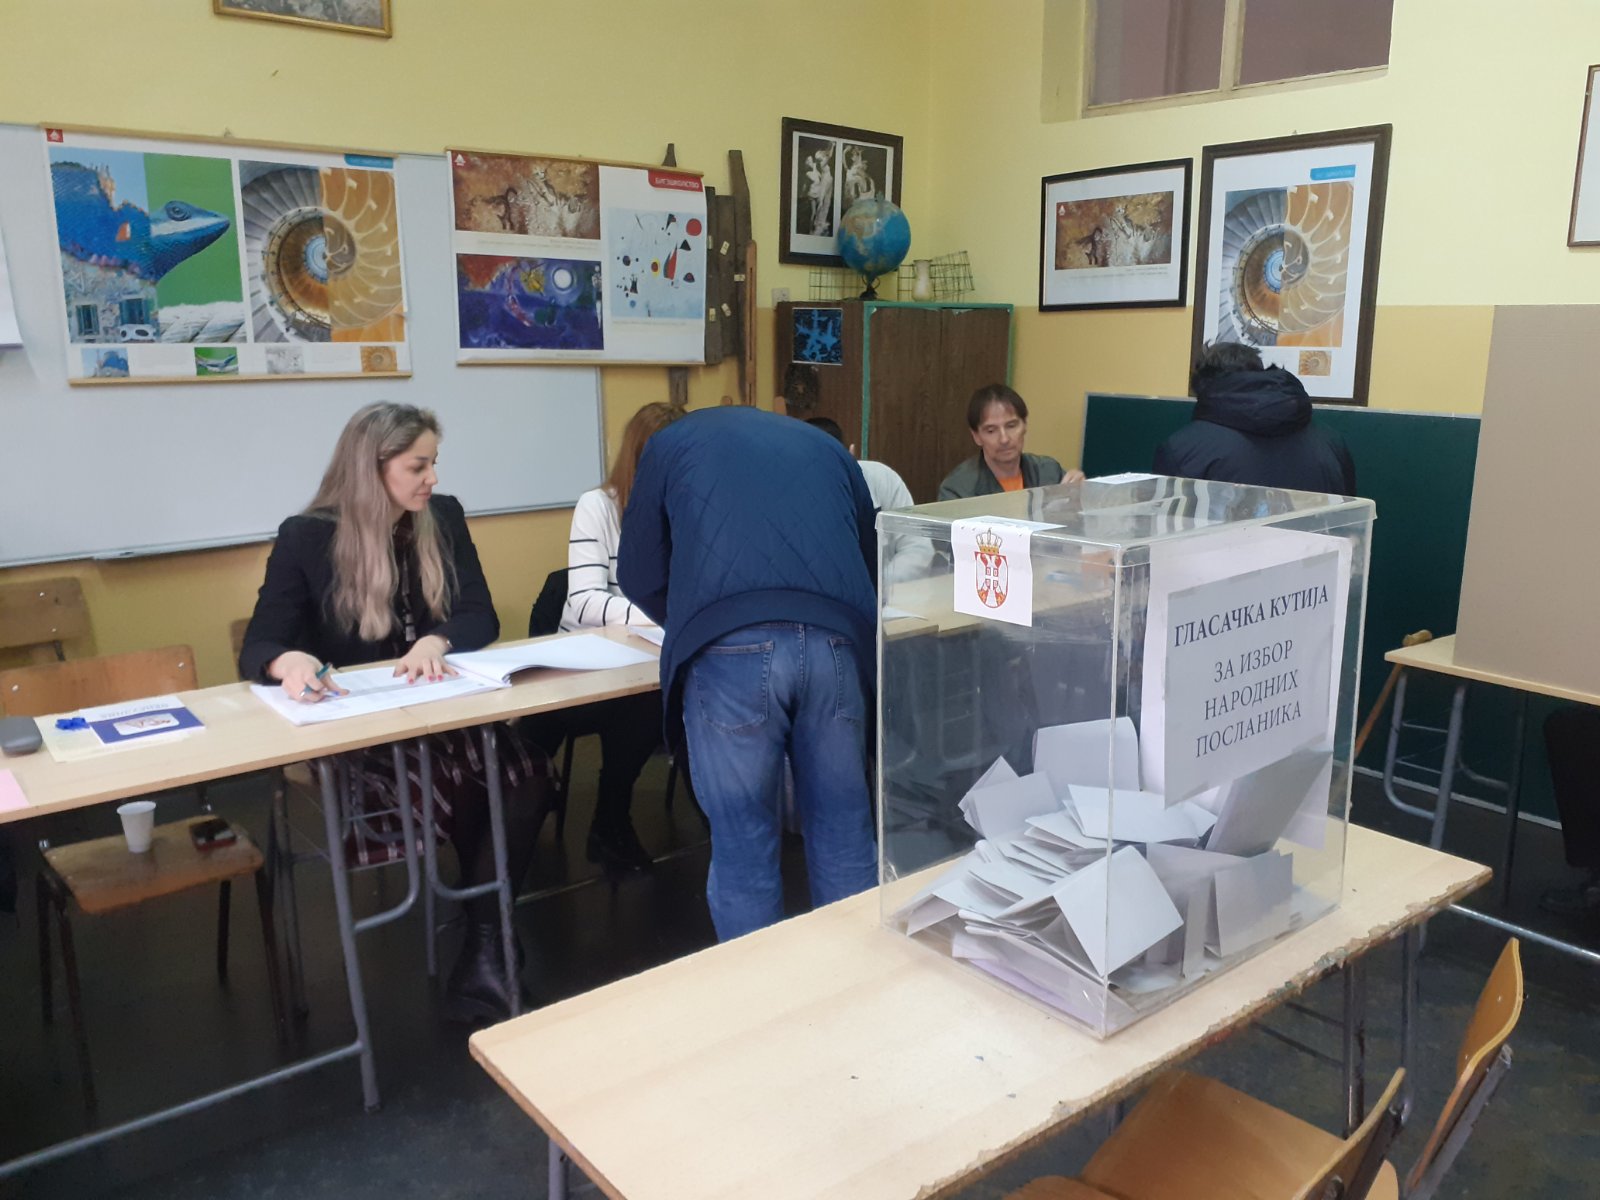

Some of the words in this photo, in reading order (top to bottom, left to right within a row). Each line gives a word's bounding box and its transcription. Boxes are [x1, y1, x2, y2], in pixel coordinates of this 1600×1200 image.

[1174, 602, 1265, 648] ГЛАСАЧКА
[1269, 584, 1329, 619] КУТИЈА
[1214, 659, 1235, 684] ЗА
[1240, 639, 1294, 675] ИЗБОР
[1204, 669, 1299, 721] НАРОДНИХ
[1196, 700, 1302, 758] ПОСЛАНИКА
